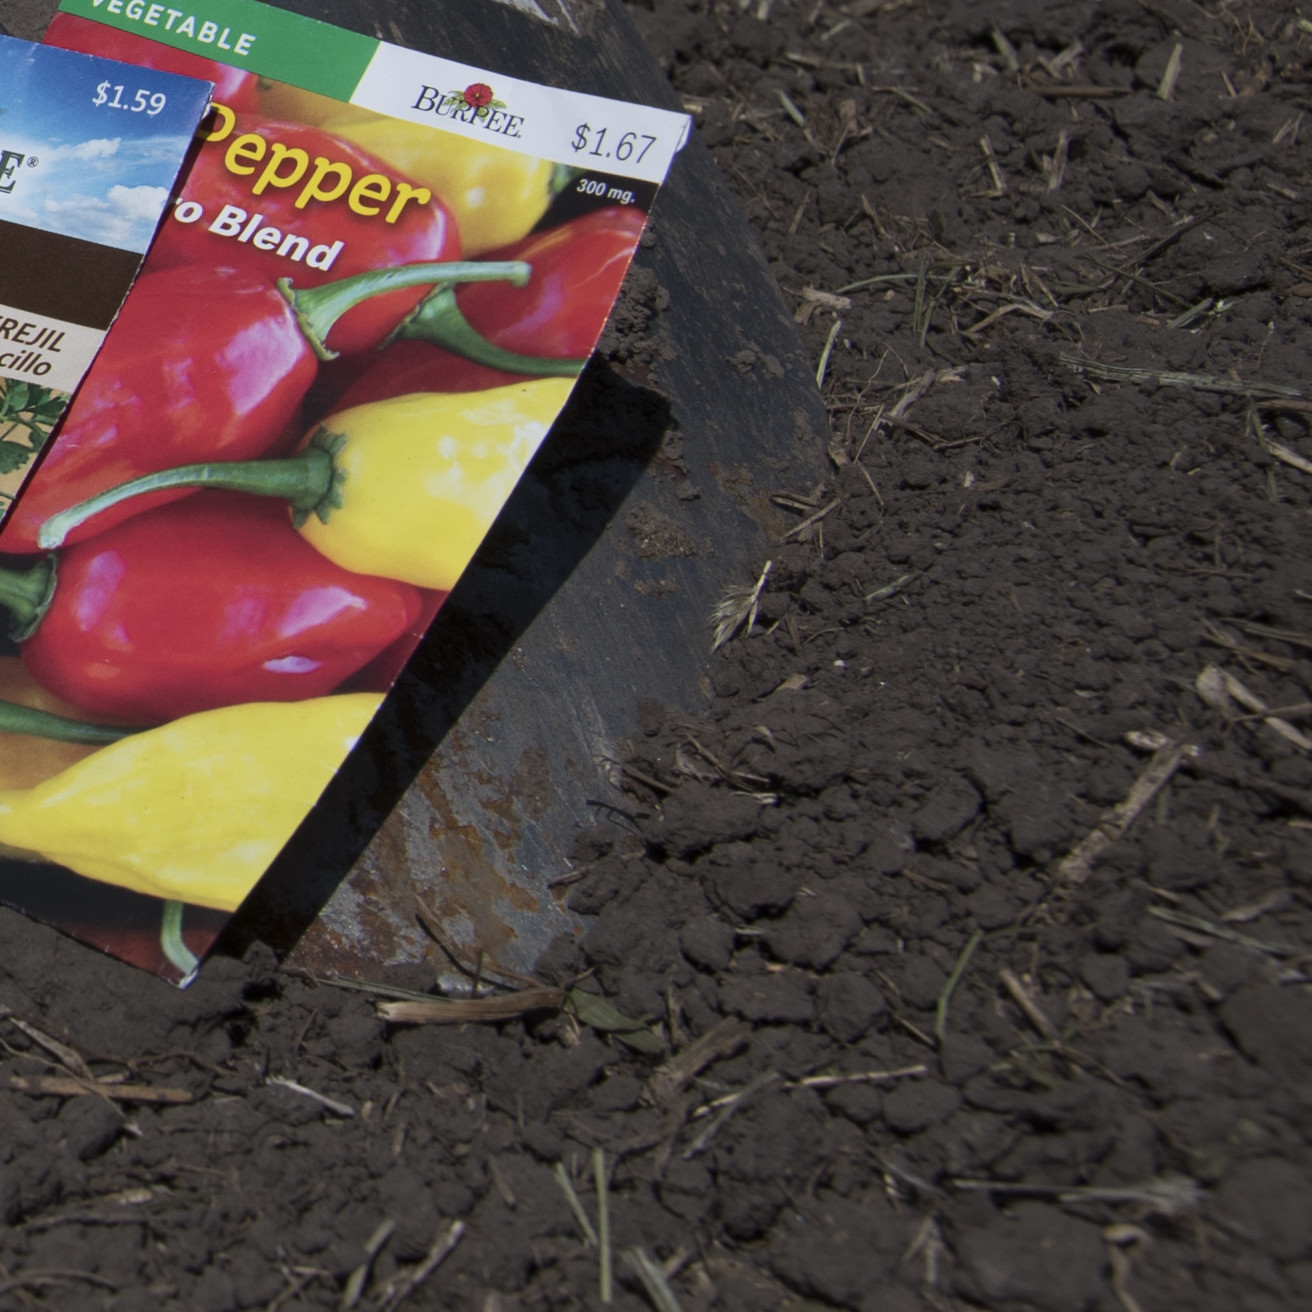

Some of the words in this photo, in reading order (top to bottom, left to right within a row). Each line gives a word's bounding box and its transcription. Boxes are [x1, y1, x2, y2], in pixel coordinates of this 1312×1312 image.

[91, 79, 167, 116] $1.59
[571, 122, 658, 164] $1.67
[576, 178, 606, 197] 300
[606, 184, 636, 205] mg.
[207, 203, 345, 272] Blend
